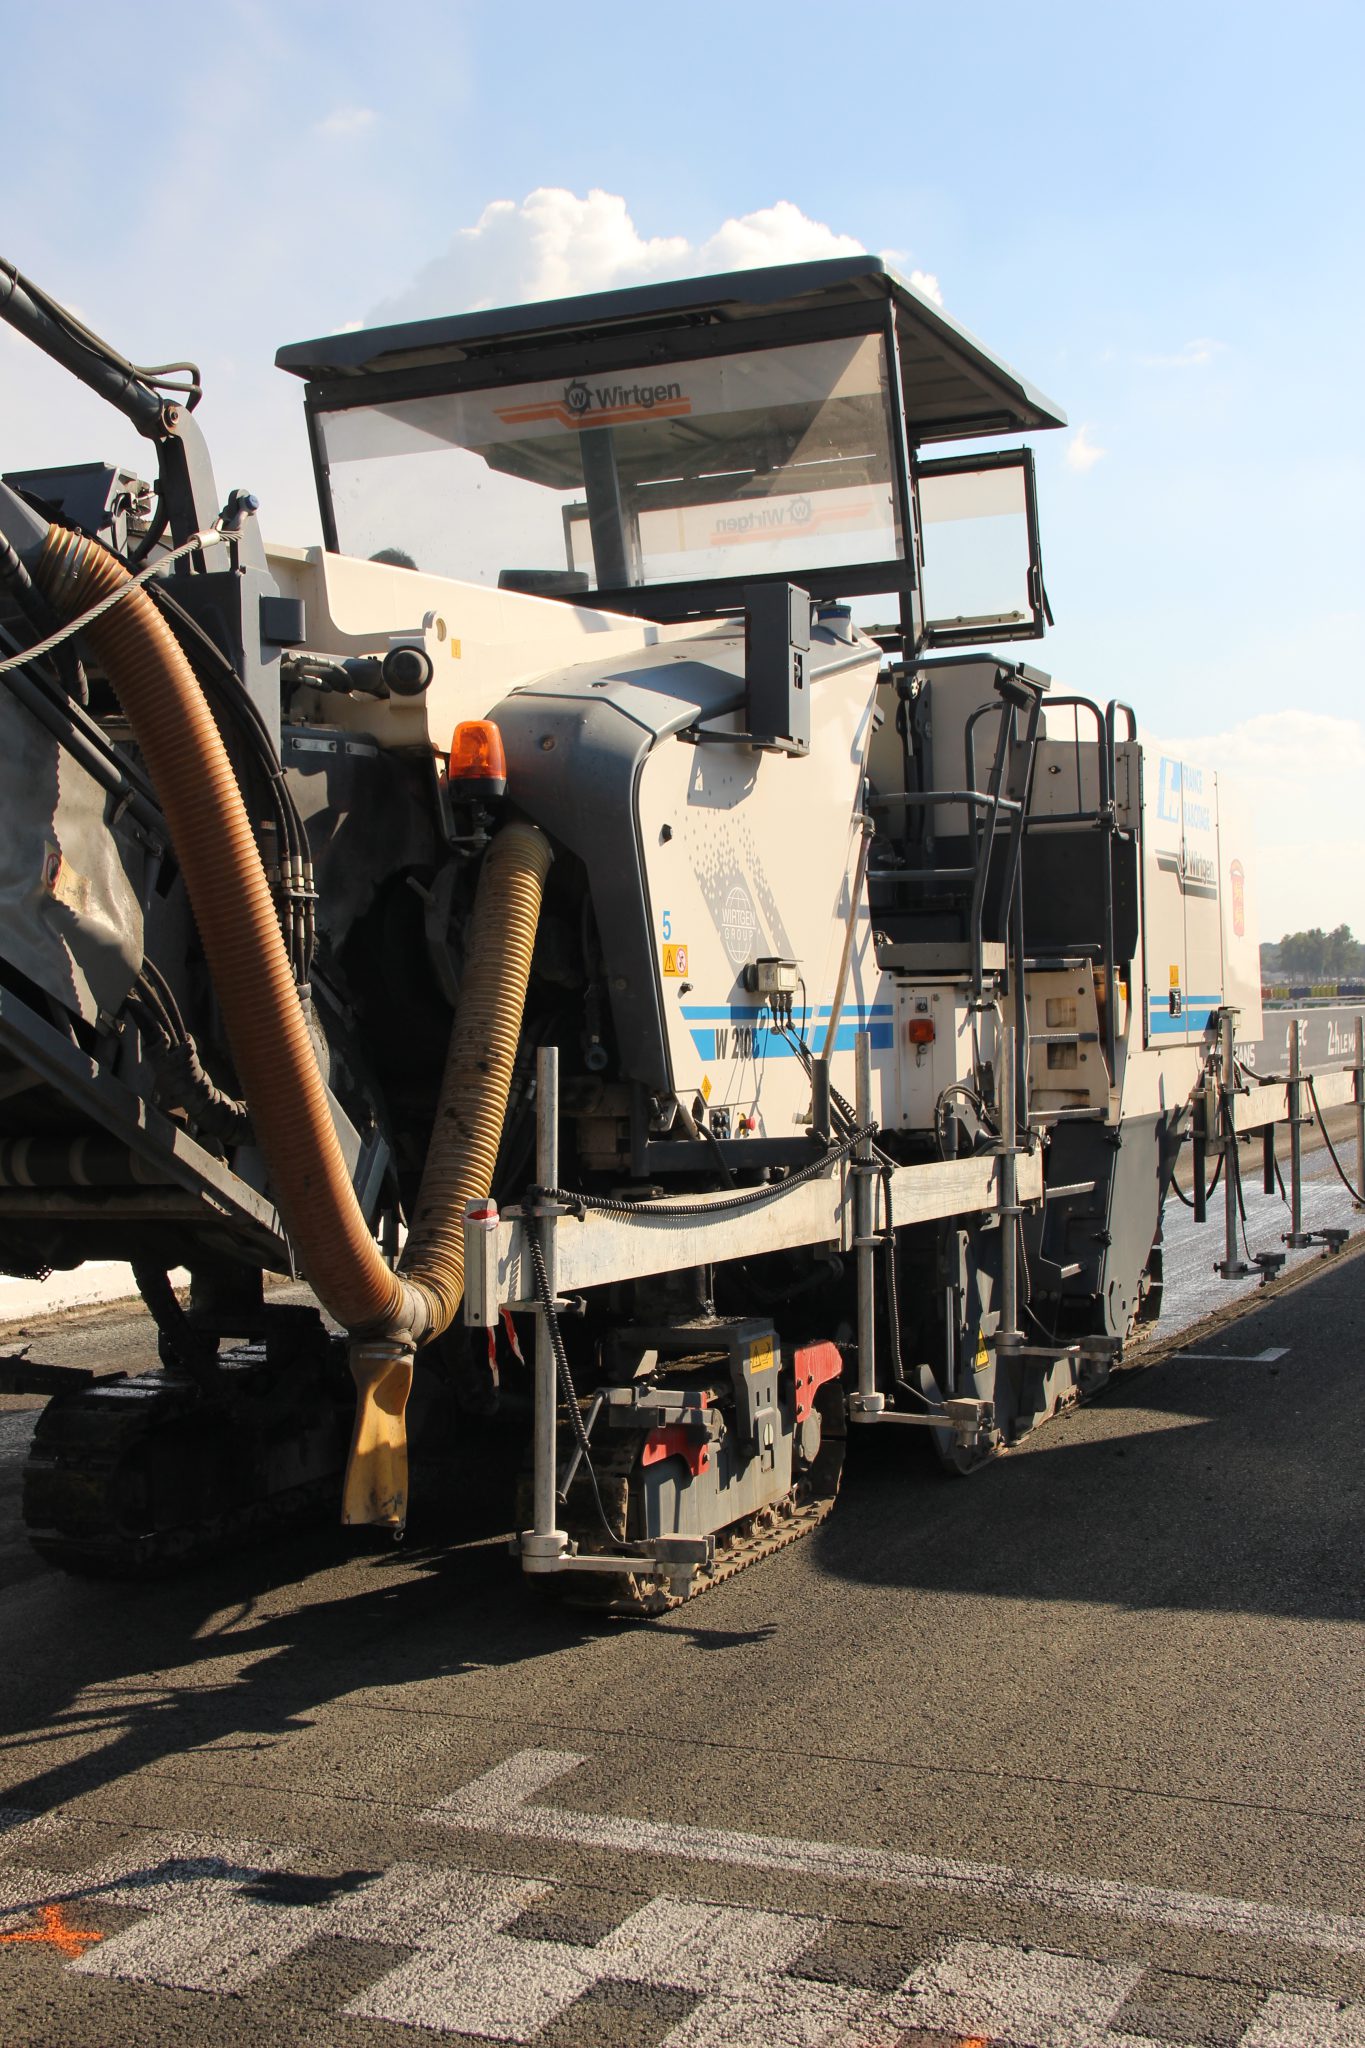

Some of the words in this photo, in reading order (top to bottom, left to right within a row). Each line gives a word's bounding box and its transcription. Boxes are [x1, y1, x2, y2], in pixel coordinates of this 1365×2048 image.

[595, 383, 681, 408] Wirtgen
[1188, 849, 1215, 884] Wirtgen
[663, 910, 671, 940] 5
[722, 908, 756, 926] WIRTGEN
[724, 927, 754, 942] GROUP
[716, 1028, 729, 1060] W
